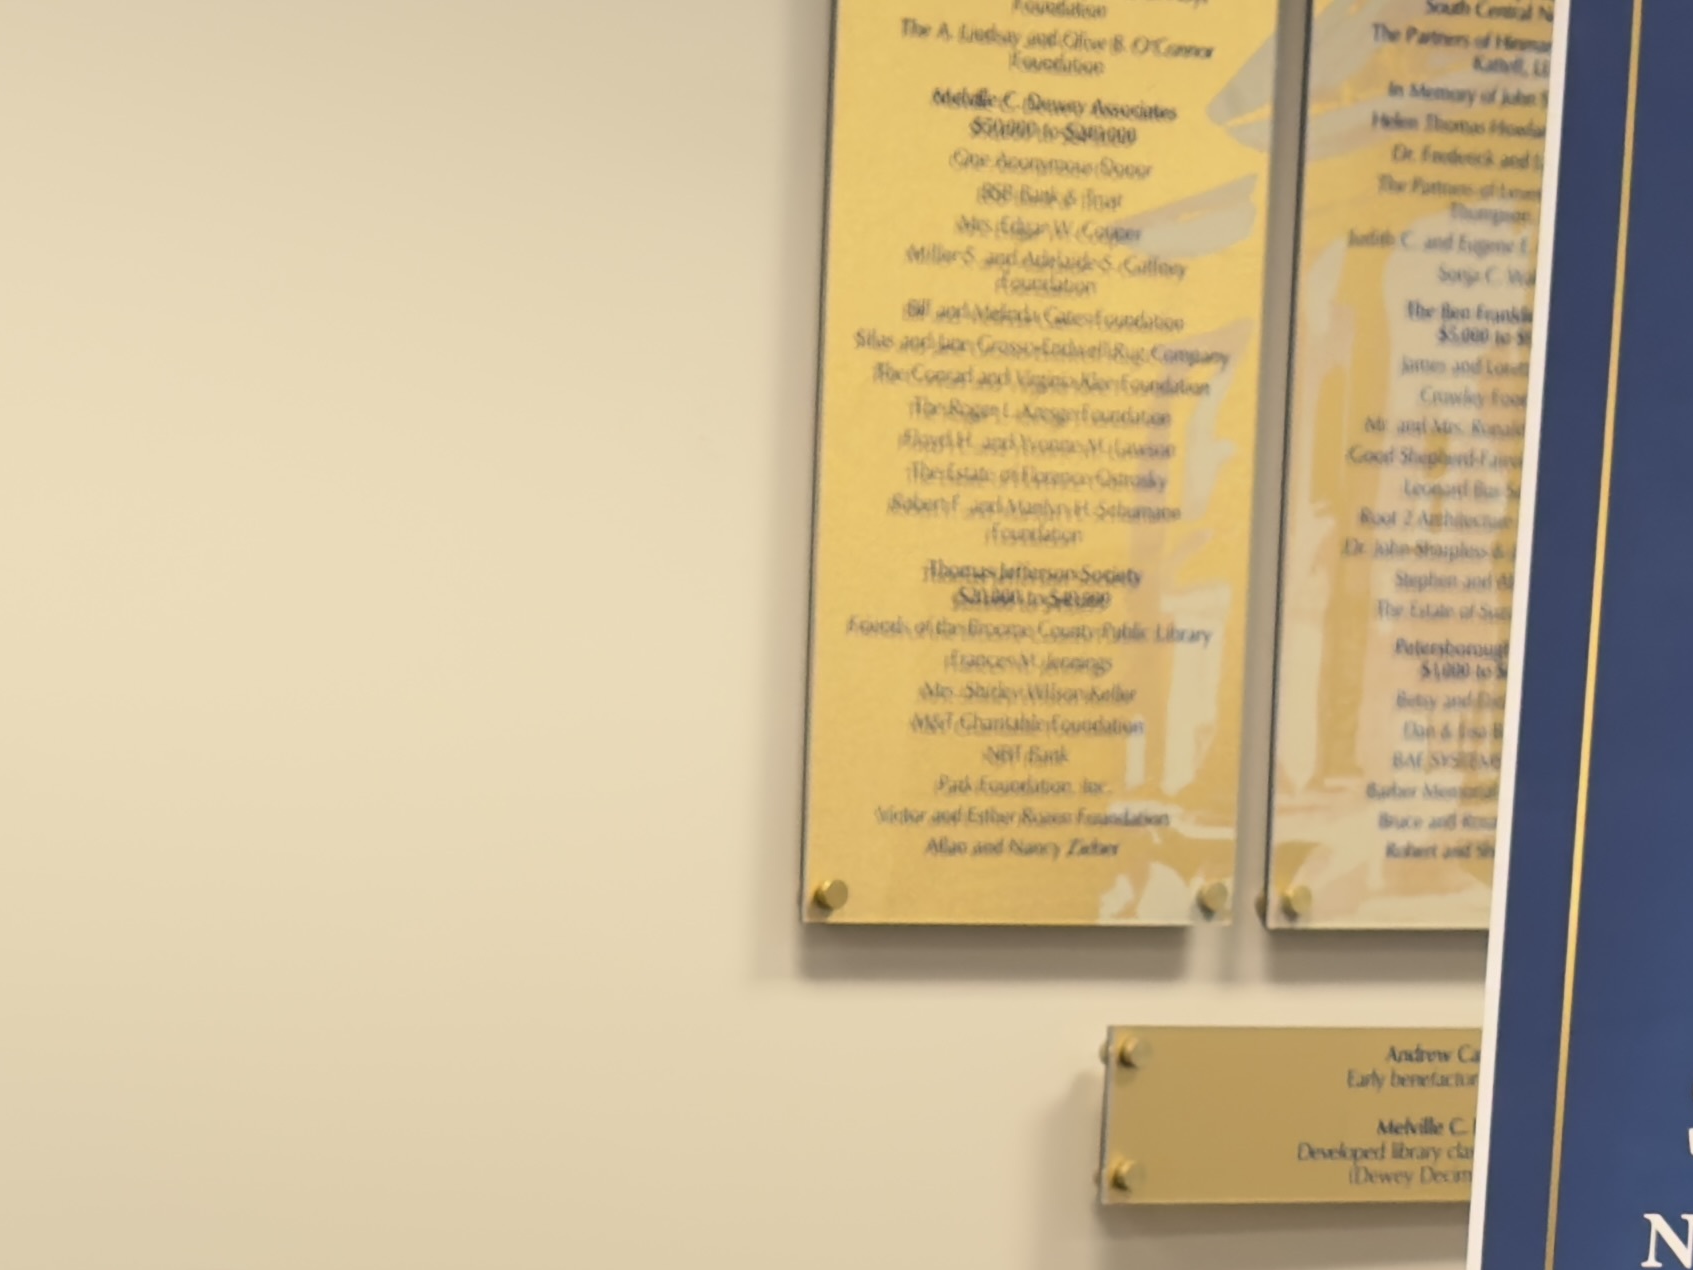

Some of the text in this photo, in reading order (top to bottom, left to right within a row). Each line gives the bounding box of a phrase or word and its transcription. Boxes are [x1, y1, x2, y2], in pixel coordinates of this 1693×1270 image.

[1347, 1069, 1384, 1091] Early
[1297, 1141, 1385, 1164] Developed
[1392, 1142, 1440, 1163] library
